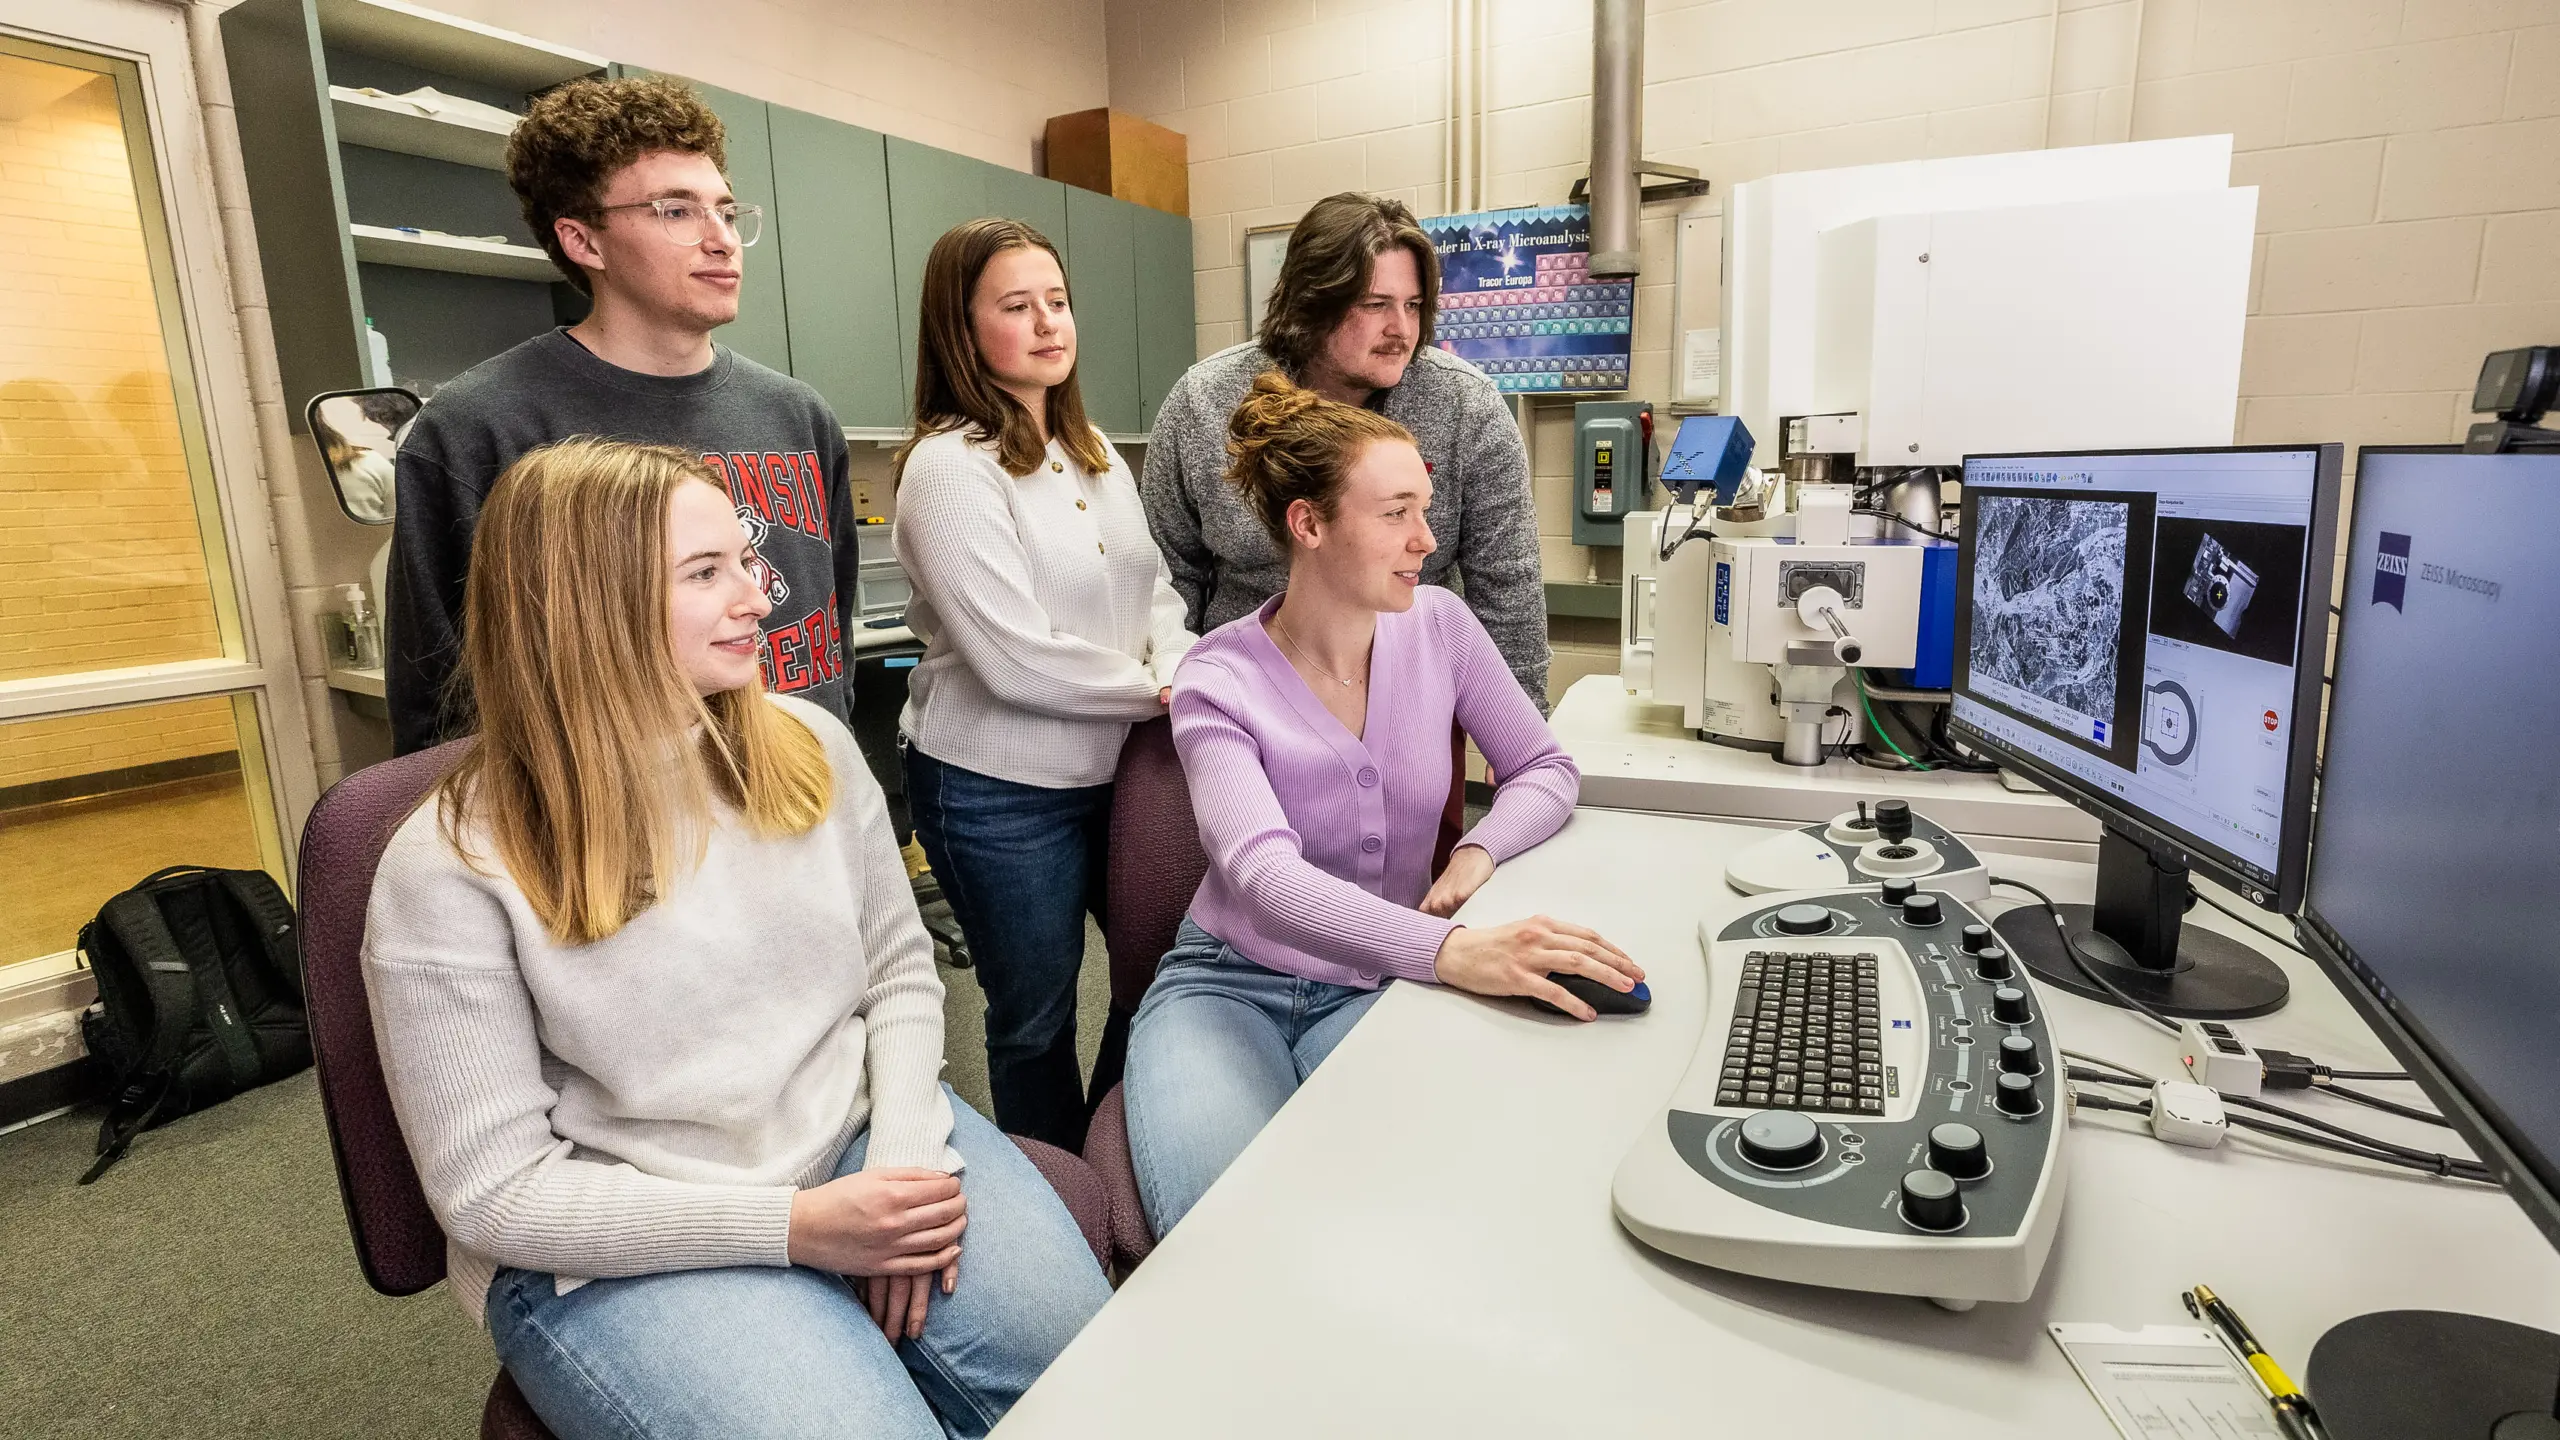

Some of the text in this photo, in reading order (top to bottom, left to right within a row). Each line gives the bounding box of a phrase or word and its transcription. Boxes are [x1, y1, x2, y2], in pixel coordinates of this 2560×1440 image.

[1434, 230, 1590, 254] ader in X-ray Microanalysis
[1478, 274, 1532, 288] Tracor Europa
[2377, 552, 2408, 576] ZEISS
[2420, 563, 2503, 602] ZEISS Microscopy
[2264, 716, 2277, 726] STOP
